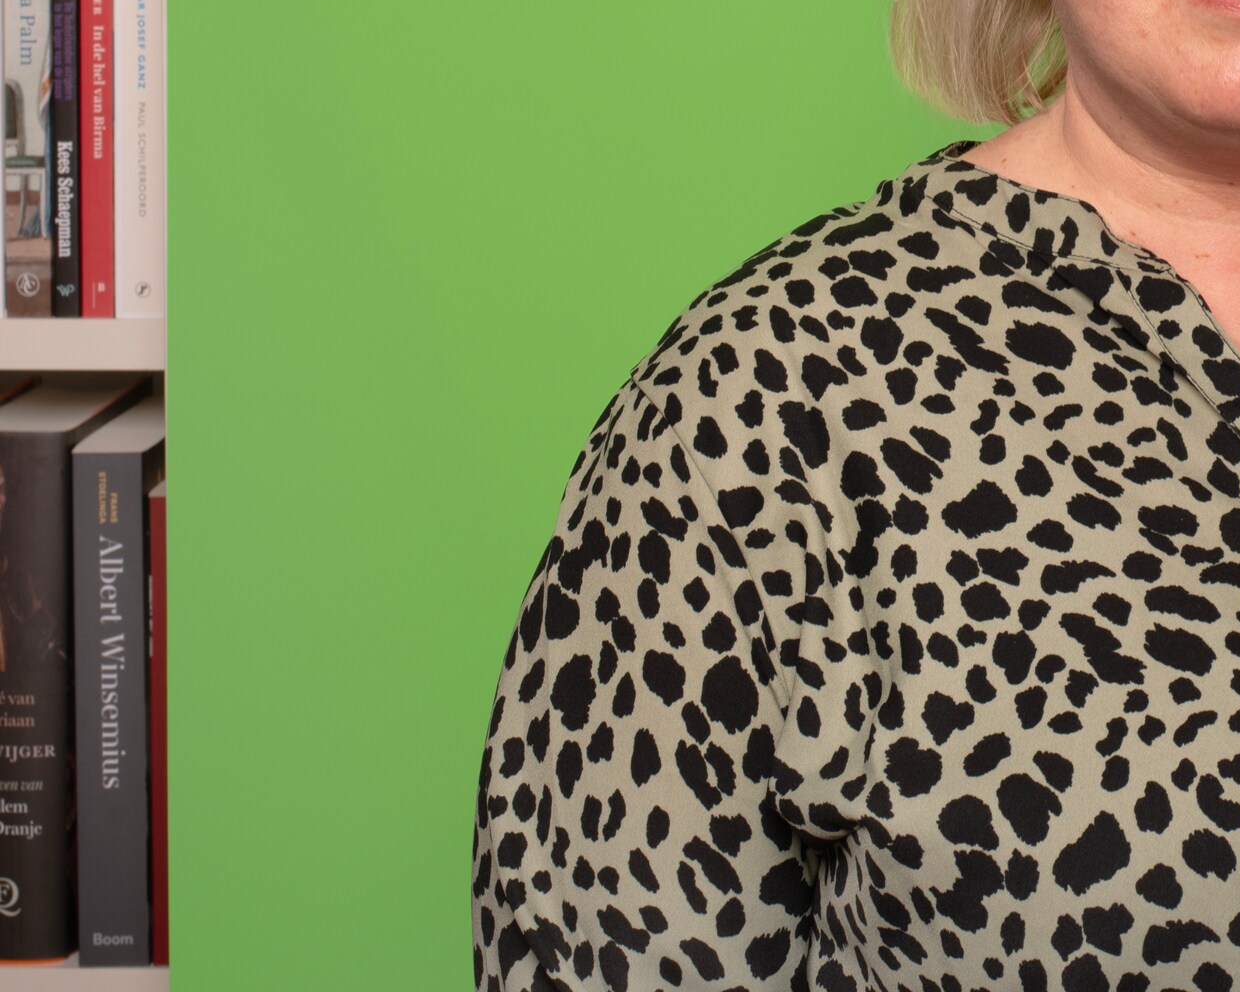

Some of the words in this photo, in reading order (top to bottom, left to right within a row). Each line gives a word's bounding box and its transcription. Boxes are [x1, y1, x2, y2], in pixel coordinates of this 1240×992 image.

[19, 15, 35, 66] Palm
[92, 25, 105, 40] In
[136, 14, 146, 50] JOSEF
[92, 42, 105, 60] de
[92, 64, 105, 84] hel
[137, 55, 146, 89] GANZ
[93, 88, 102, 112] van
[138, 102, 146, 127] PAUL
[93, 116, 105, 158] Birma
[57, 142, 73, 172] Kees
[138, 132, 147, 217] SCHILPEROORD
[55, 177, 73, 257] Schaepman
[109, 493, 118, 524] FRANS
[99, 536, 123, 624] Albert
[101, 633, 125, 789] Winsemius
[93, 933, 134, 945] Boom
